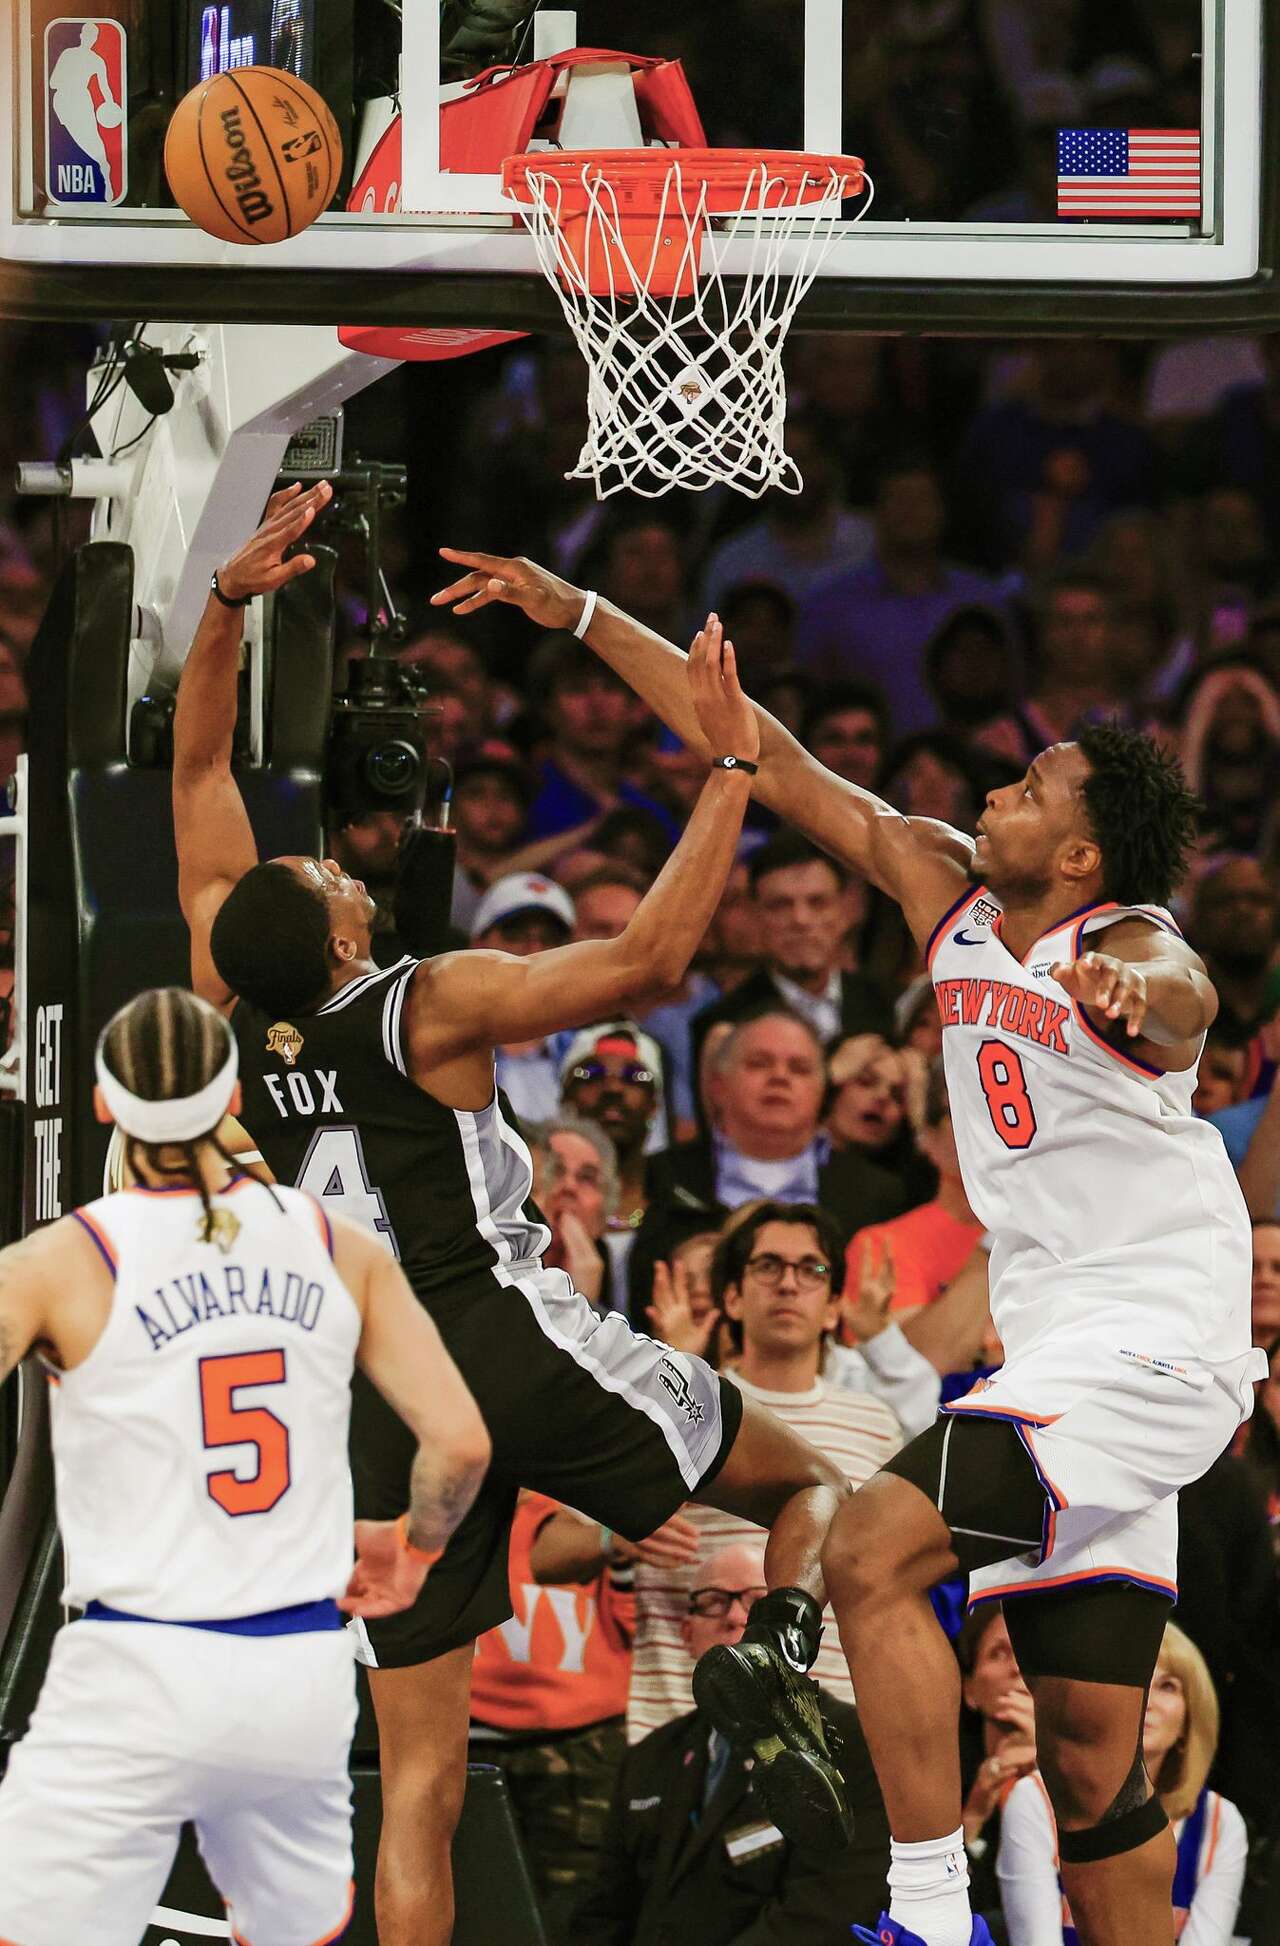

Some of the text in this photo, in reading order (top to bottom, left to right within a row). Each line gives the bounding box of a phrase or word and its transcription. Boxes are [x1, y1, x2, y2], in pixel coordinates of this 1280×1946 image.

[58, 164, 95, 193] NBA
[220, 105, 274, 225] Wilson
[35, 1003, 63, 1108] GET
[935, 978, 1072, 1057] NEW YORK
[262, 1068, 345, 1118] FOX
[976, 1038, 1037, 1149] 8
[34, 1117, 62, 1221] THE
[293, 1123, 402, 1262] 4
[134, 1265, 325, 1351] ALVARADO
[198, 1347, 291, 1518] 5
